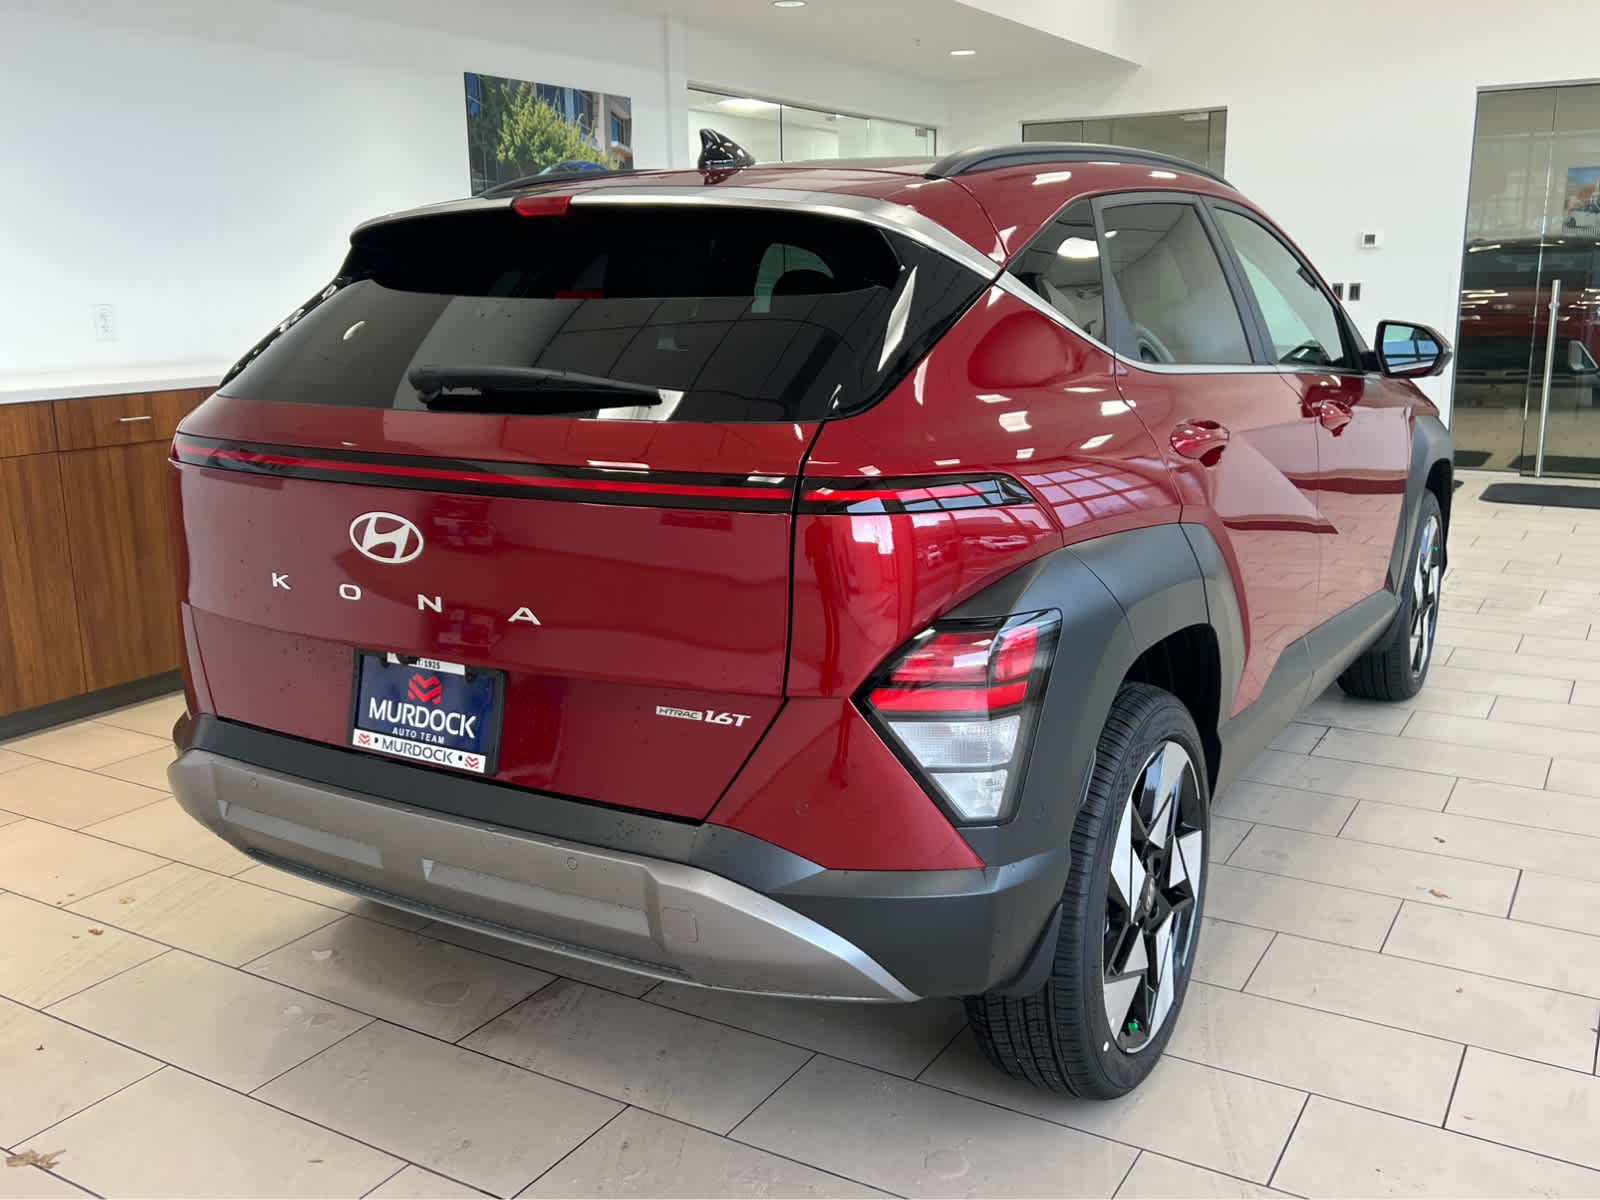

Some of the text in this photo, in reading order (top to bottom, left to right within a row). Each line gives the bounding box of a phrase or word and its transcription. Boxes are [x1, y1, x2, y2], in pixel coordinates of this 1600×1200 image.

[271, 572, 541, 626] KONA
[369, 696, 477, 738] MURDOCK
[658, 707, 700, 719] HTRAC
[392, 727, 445, 744] AUTO TEAM
[381, 738, 454, 764] MURDOCK
